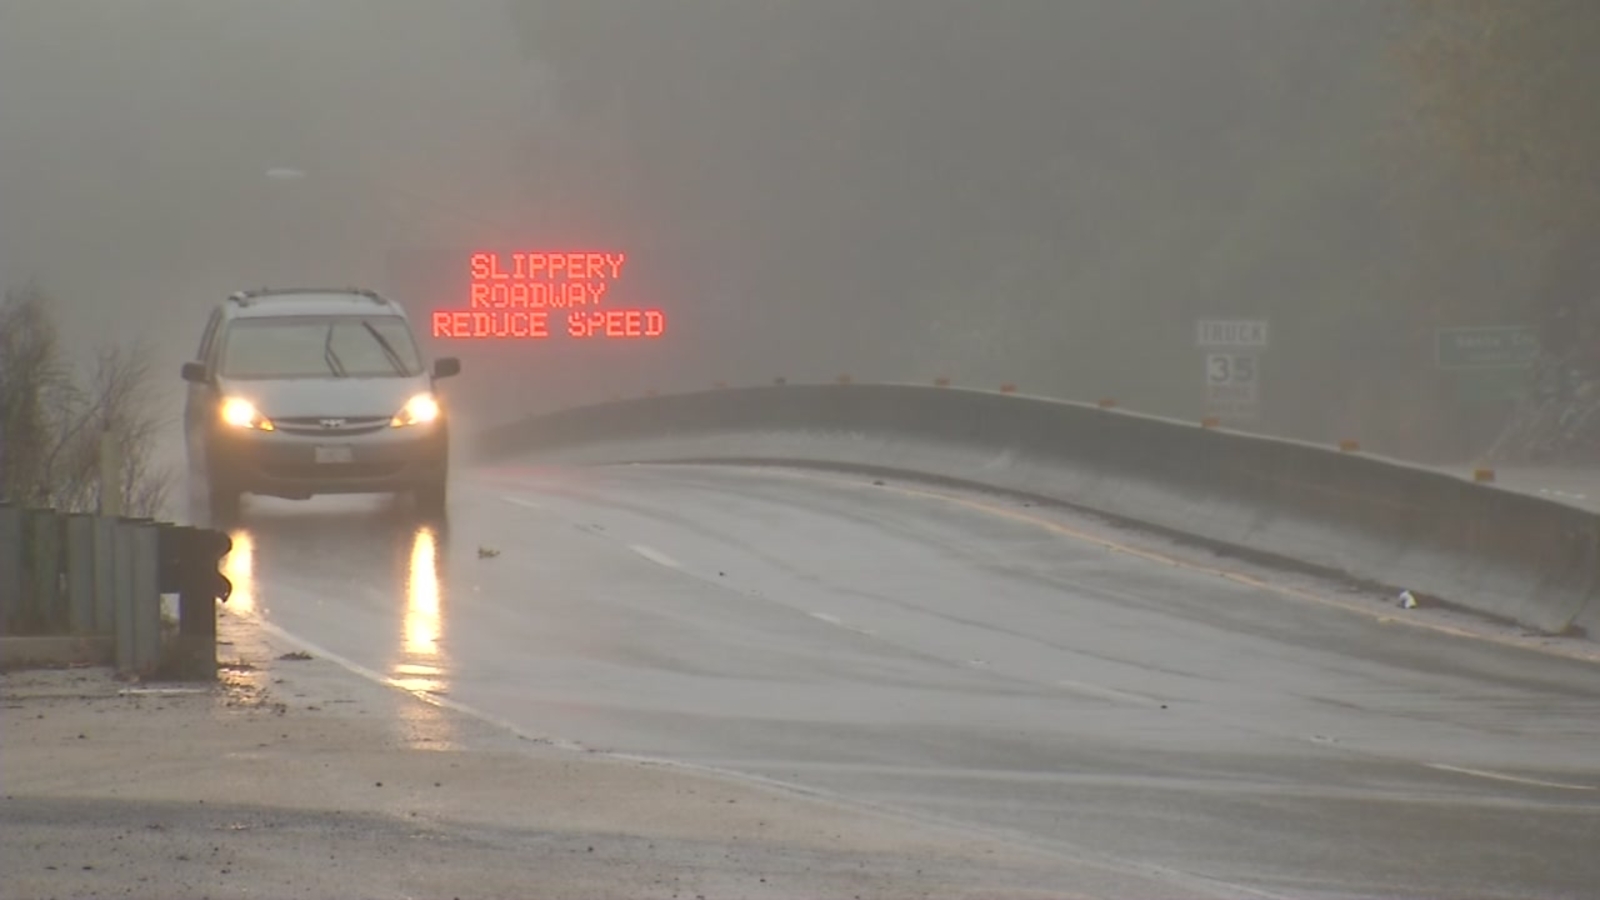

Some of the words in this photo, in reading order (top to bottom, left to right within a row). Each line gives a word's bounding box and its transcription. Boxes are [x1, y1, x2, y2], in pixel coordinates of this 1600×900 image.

[471, 253, 625, 279] SLIPPERY
[471, 282, 606, 309] ROADWAY
[433, 311, 549, 338] REDUCE
[567, 311, 663, 337] SPEED
[1202, 322, 1263, 342] TRUCK
[1209, 357, 1254, 382] 35
